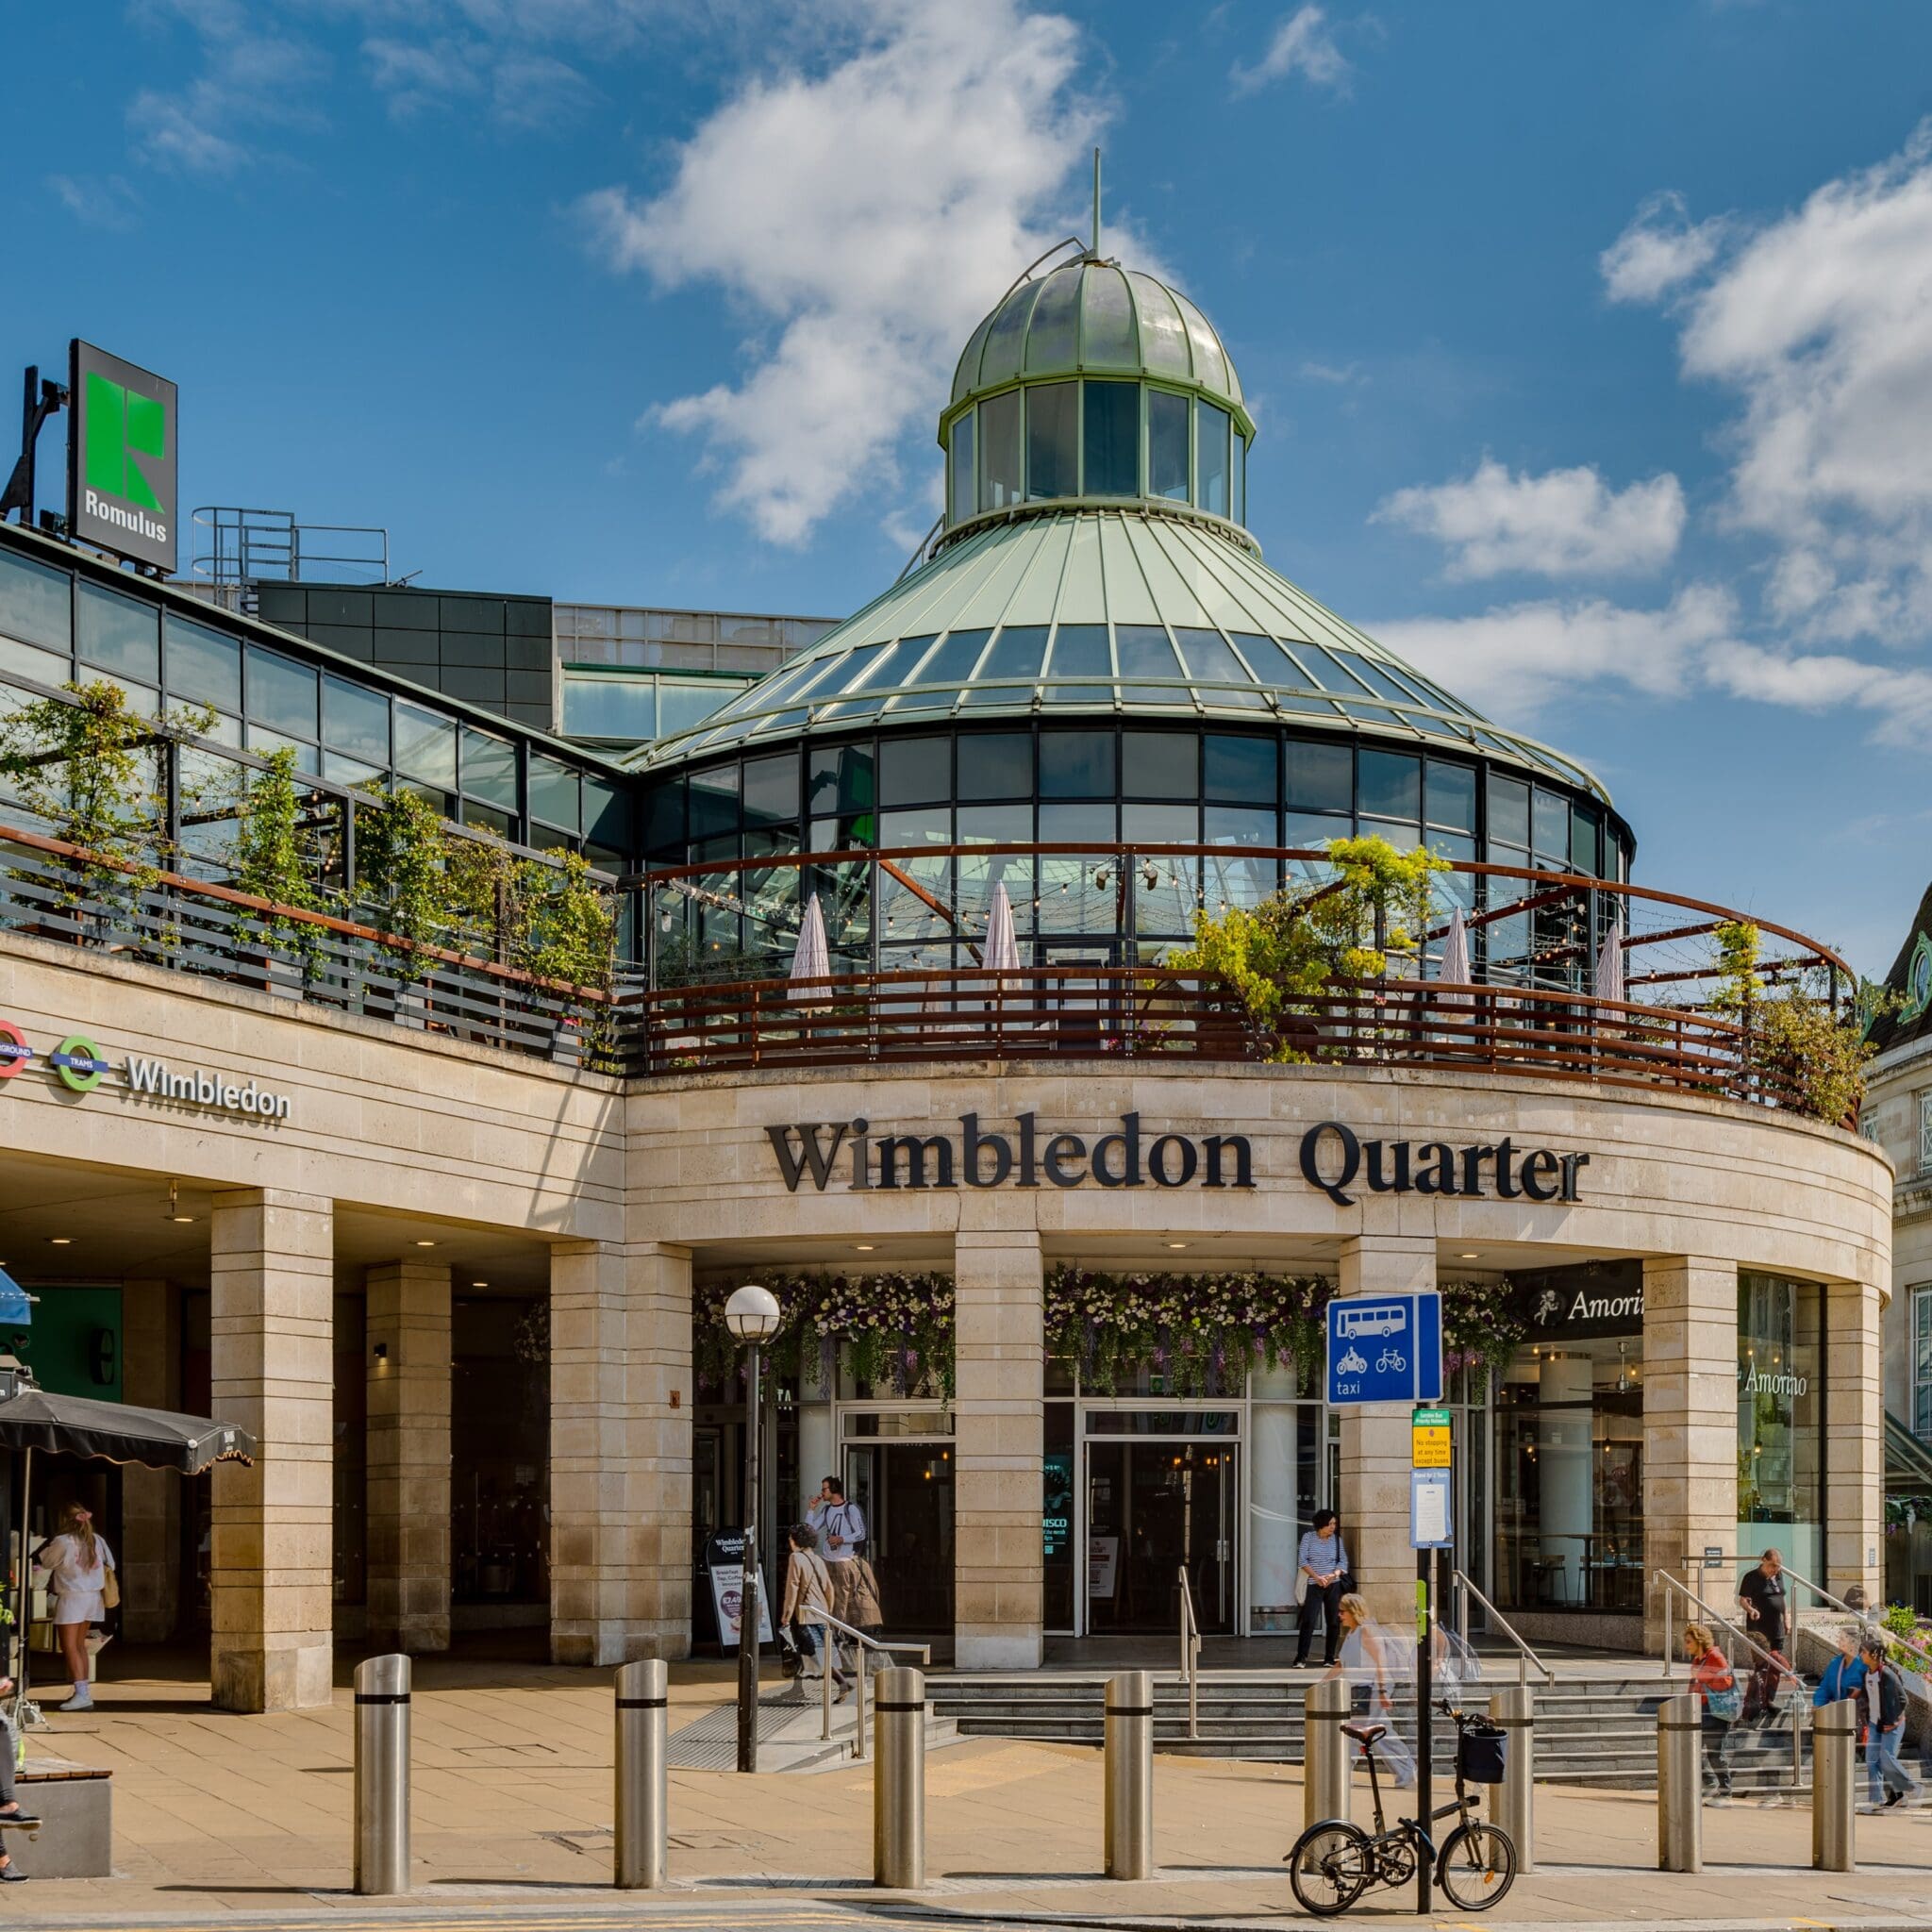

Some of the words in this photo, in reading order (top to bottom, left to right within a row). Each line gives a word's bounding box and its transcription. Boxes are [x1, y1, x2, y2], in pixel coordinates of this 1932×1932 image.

[85, 490, 167, 542] Romulus
[70, 1058, 93, 1069] TRAMS
[125, 1056, 291, 1119] Wimbledon
[763, 1111, 1257, 1192] Wimbledon
[1299, 1122, 1591, 1207] Quarter
[1337, 1380, 1360, 1395] taxi
[1744, 1361, 1807, 1396] Amorino
